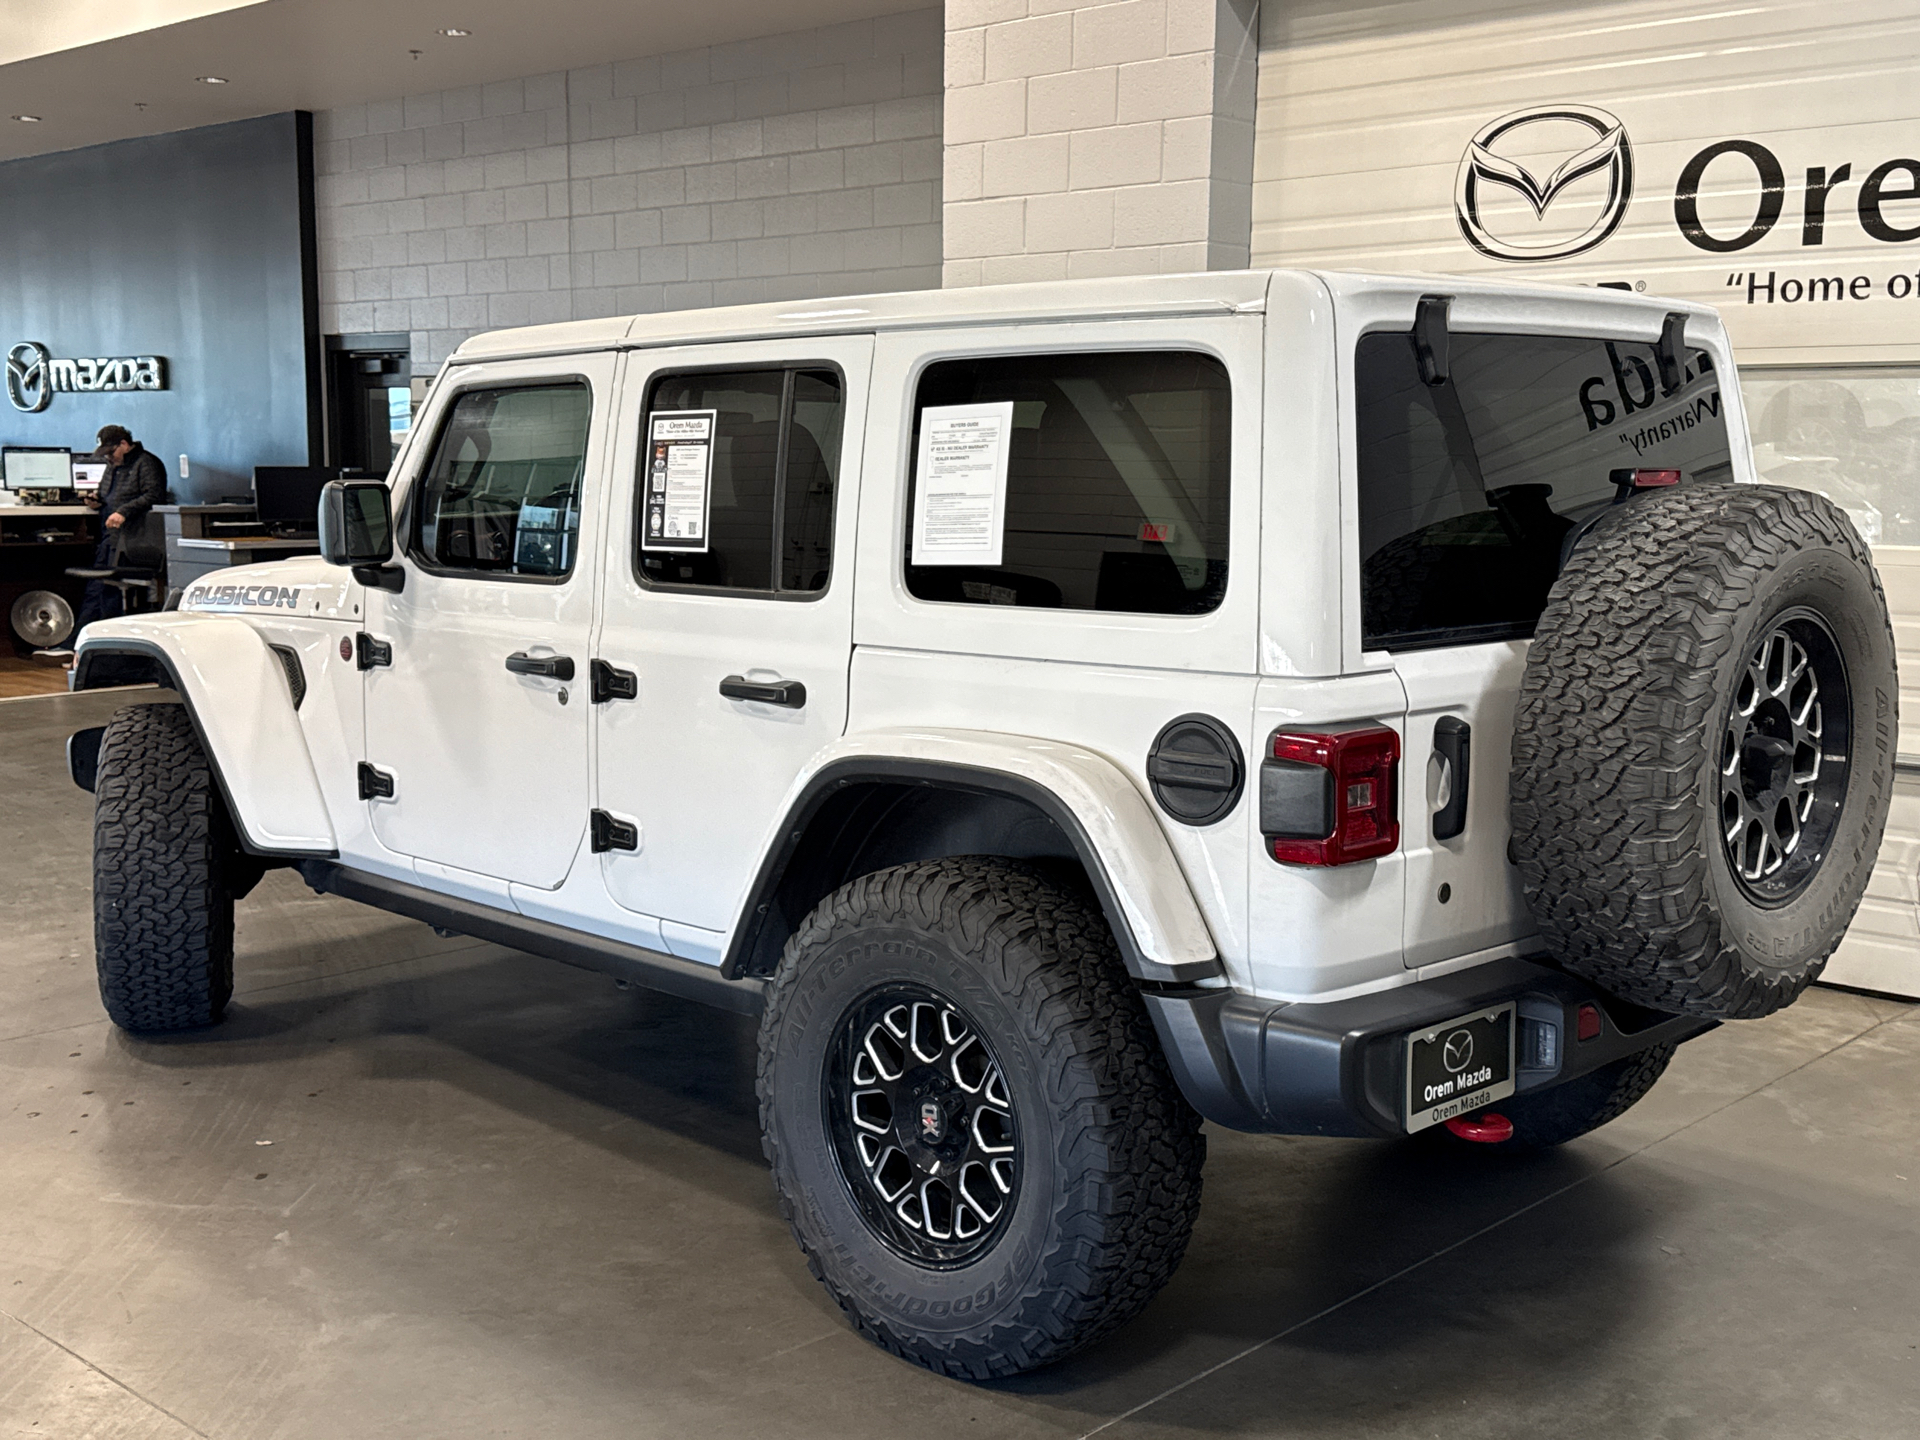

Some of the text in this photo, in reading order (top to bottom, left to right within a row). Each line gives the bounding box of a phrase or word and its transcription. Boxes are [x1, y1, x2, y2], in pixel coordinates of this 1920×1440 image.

[1674, 139, 1920, 253] Ore
[685, 421, 703, 429] Mazda
[187, 586, 301, 609] RUBICON
[1194, 768, 1217, 776] FUEL
[1424, 1066, 1491, 1102] Orem Mazda
[1432, 1090, 1491, 1122] Orem Mazda
